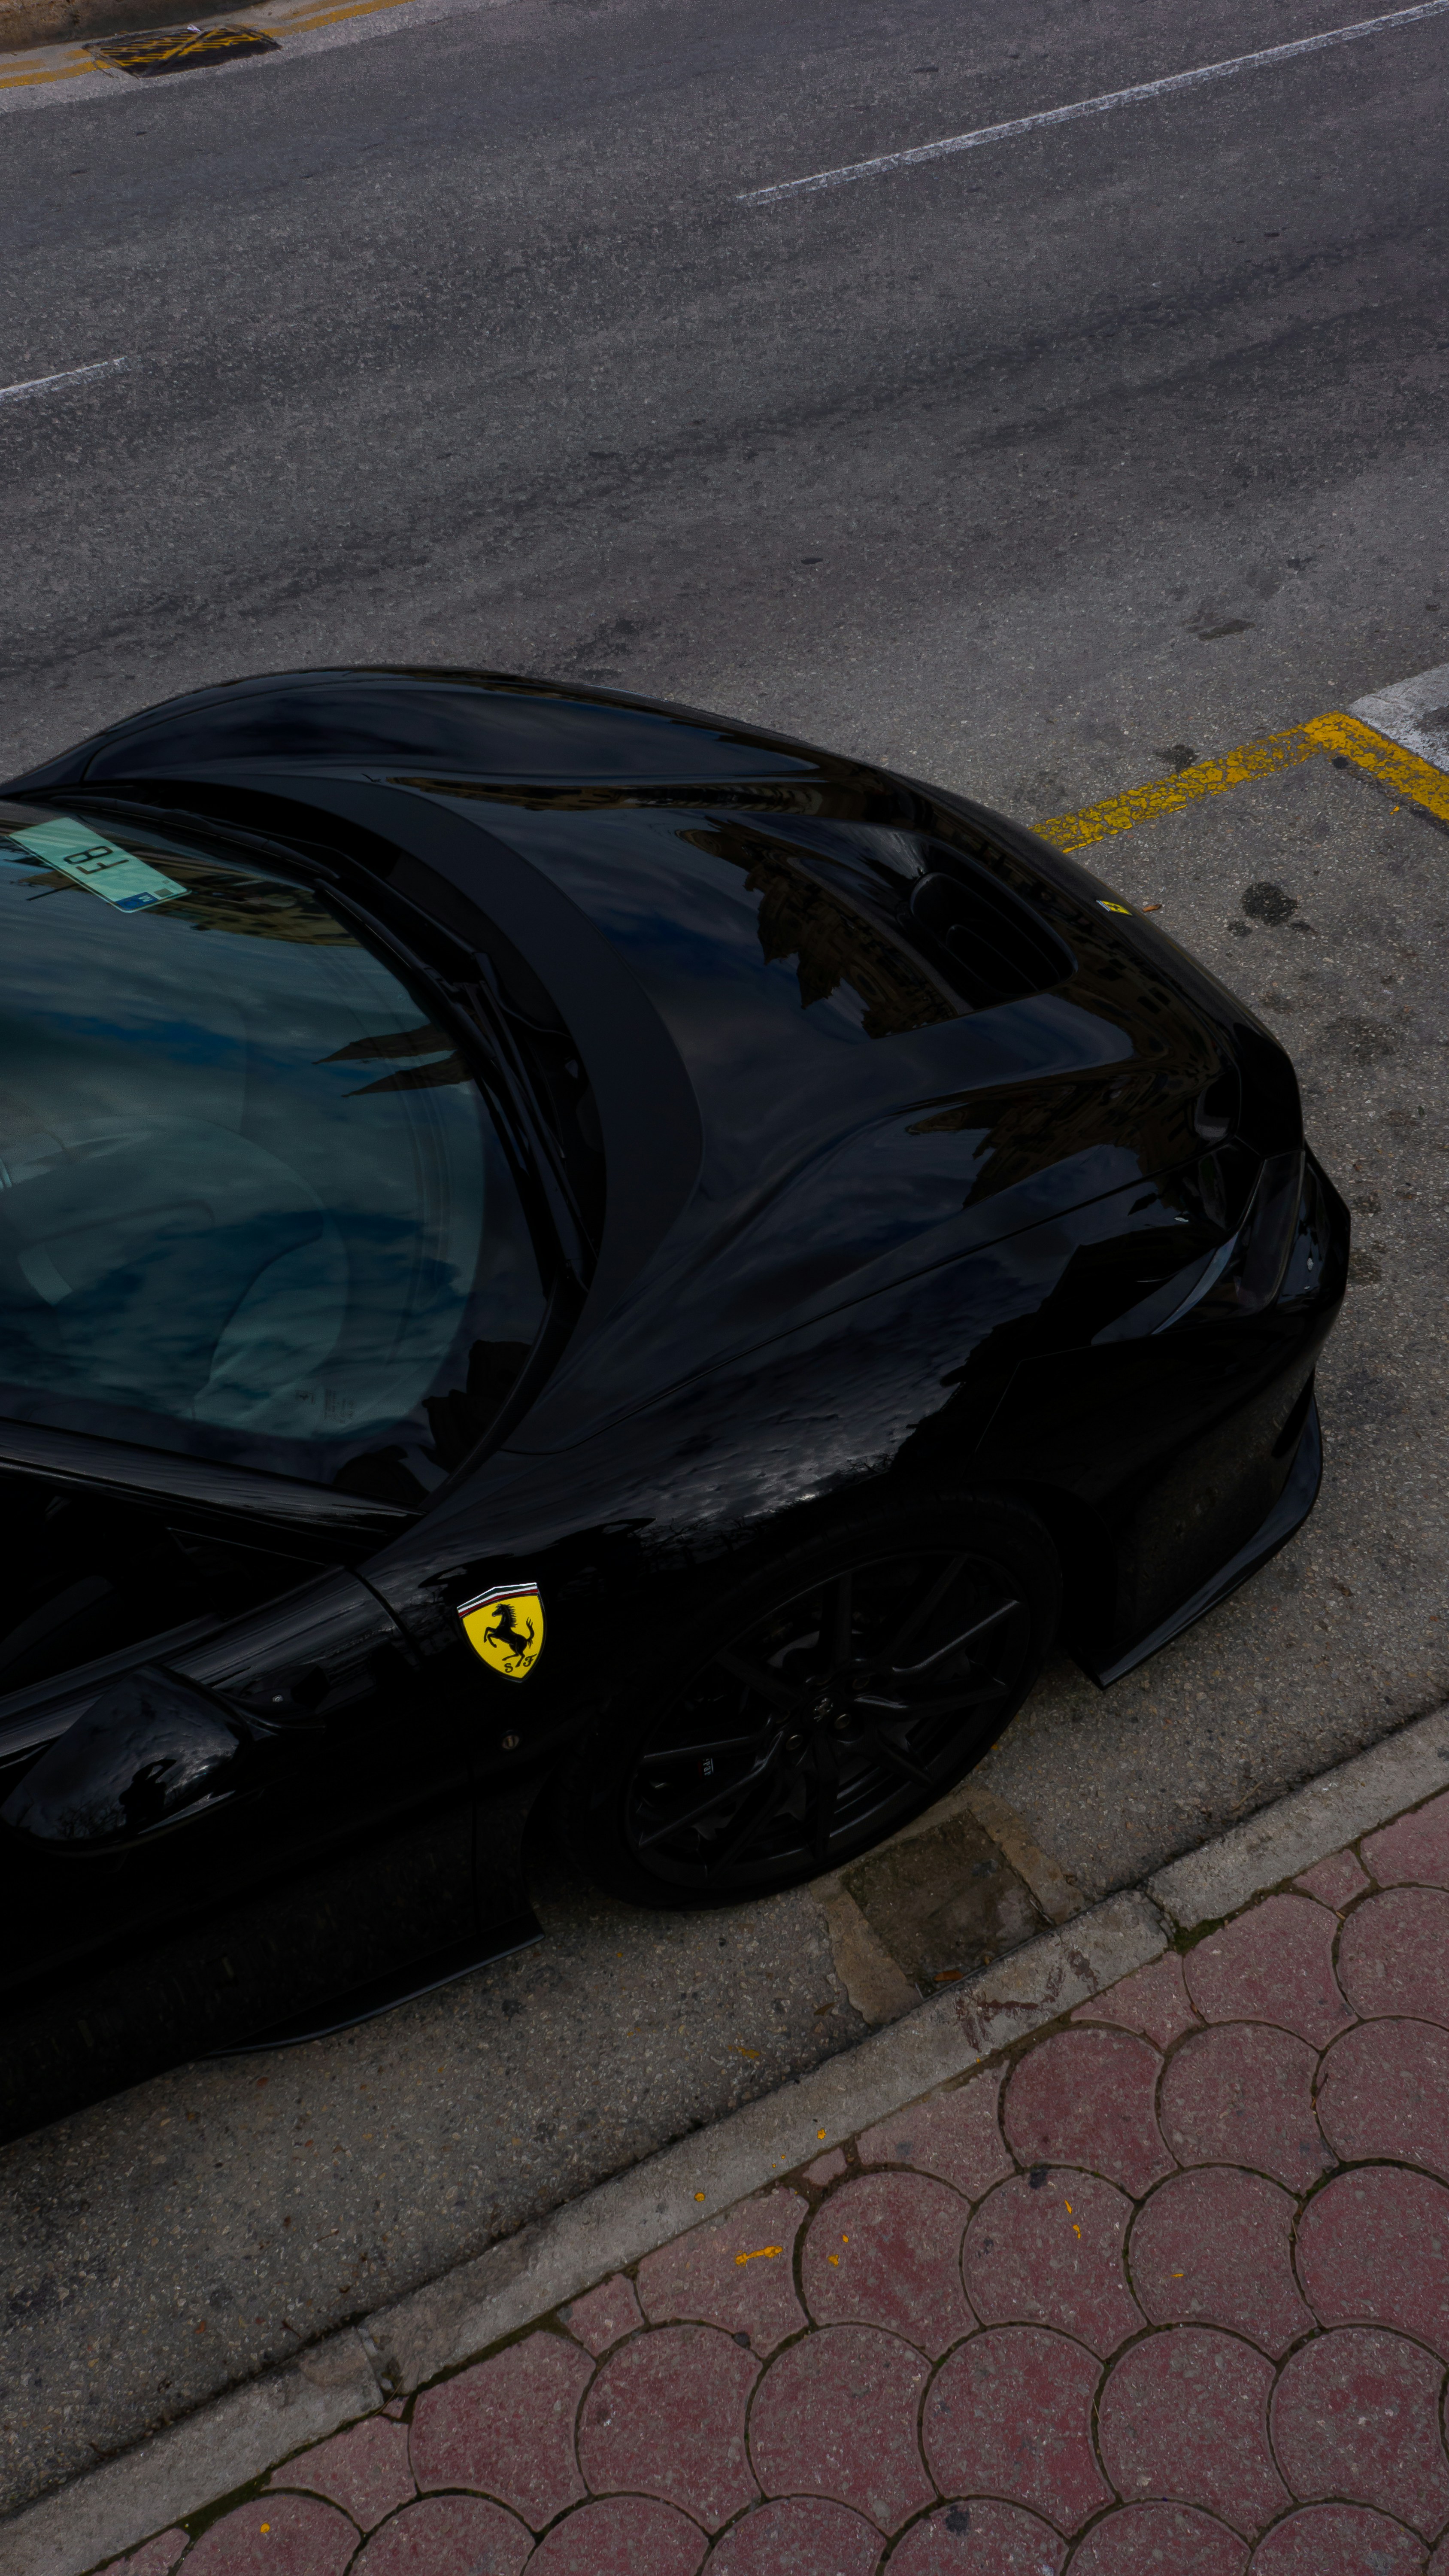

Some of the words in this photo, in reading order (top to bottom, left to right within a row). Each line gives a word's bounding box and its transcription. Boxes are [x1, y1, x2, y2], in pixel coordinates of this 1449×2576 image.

[63, 846, 130, 875] F8
[504, 1662, 513, 1673] S
[523, 1653, 537, 1667] F
